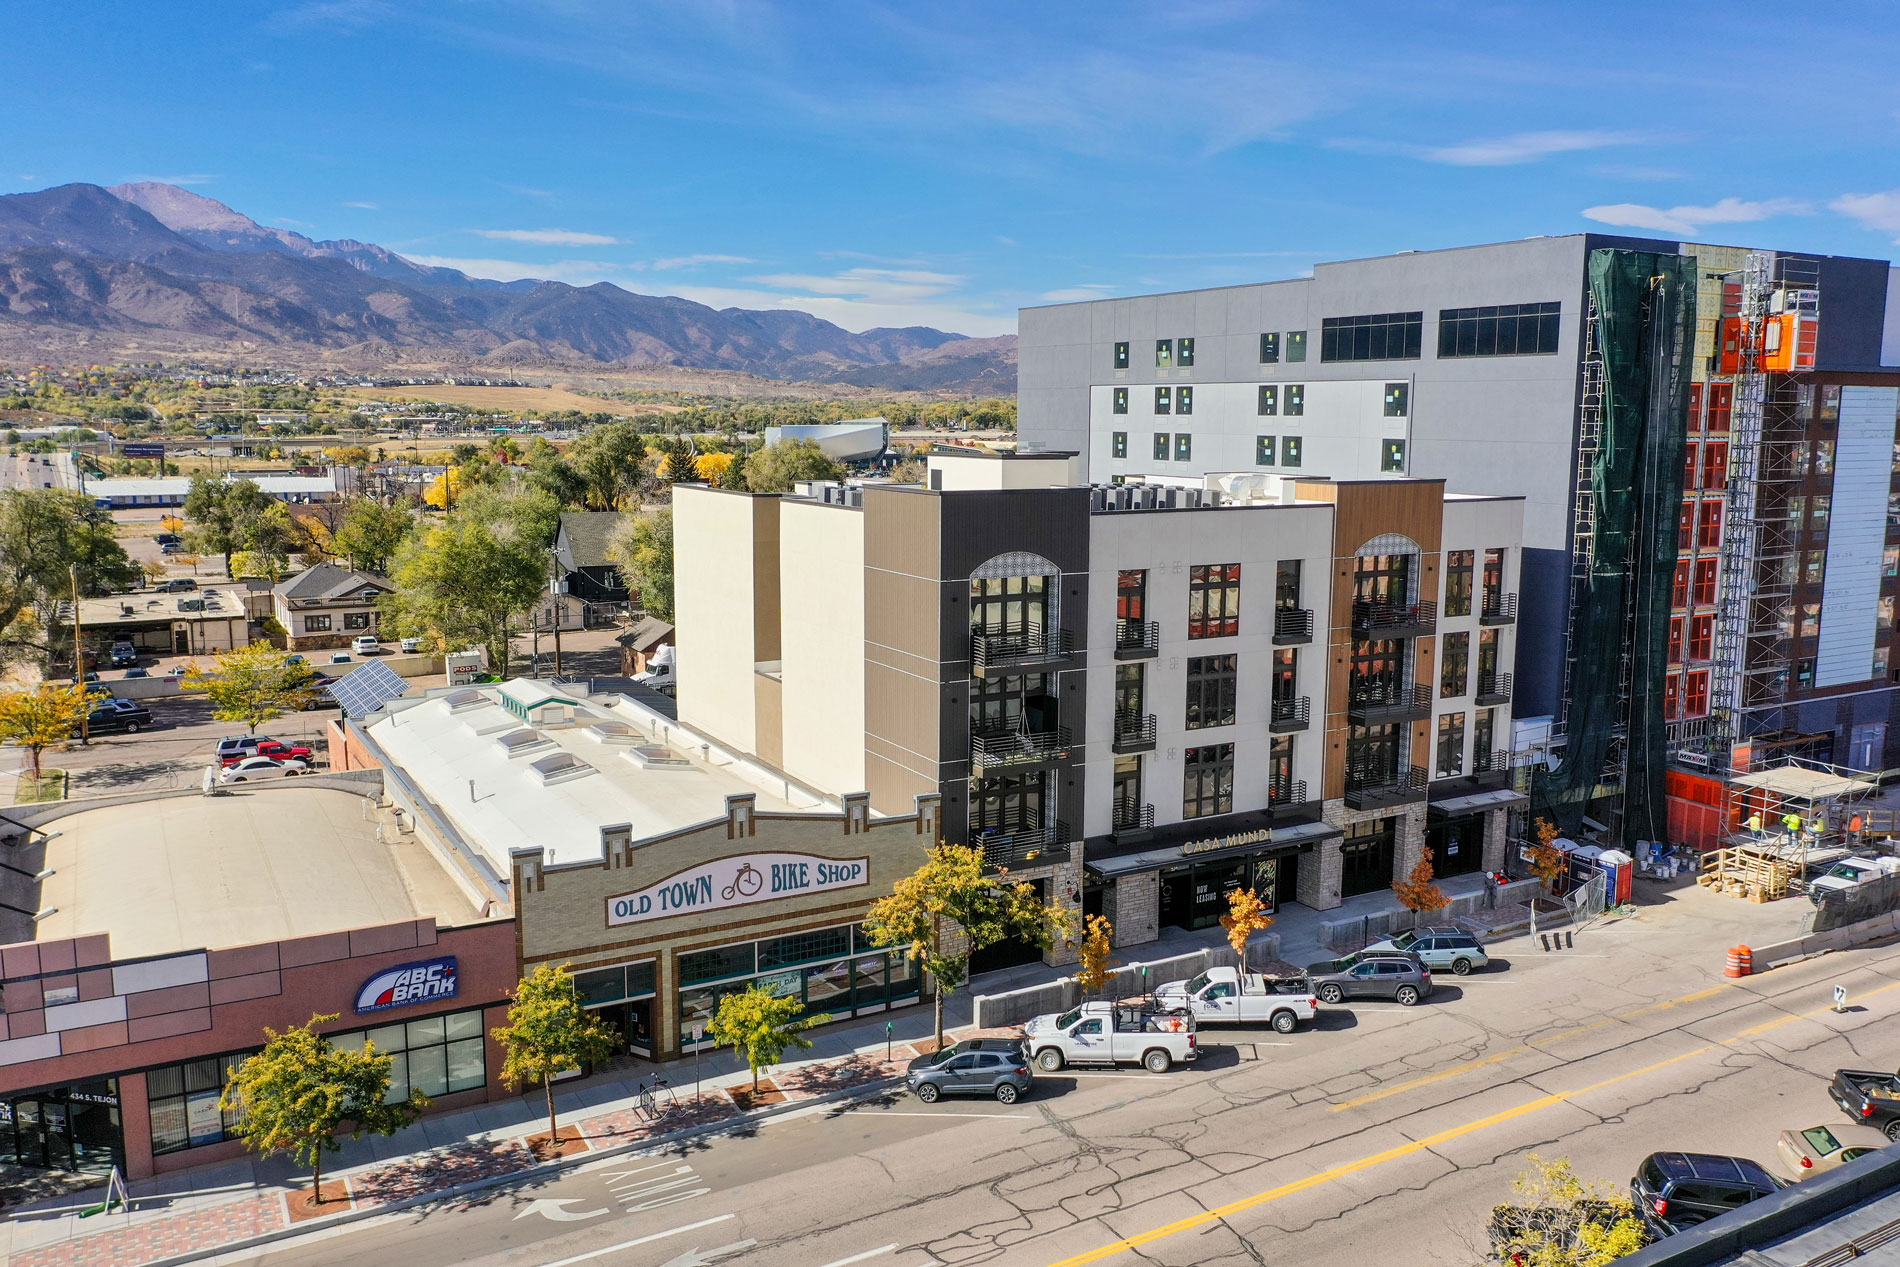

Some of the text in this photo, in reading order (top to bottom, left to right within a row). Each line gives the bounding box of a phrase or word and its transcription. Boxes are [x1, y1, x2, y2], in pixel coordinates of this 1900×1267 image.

[1183, 828, 1272, 854] CASA MUNDI
[615, 863, 861, 918] OLD TOWN BIKE SHOP
[1196, 885, 1208, 894] NOW
[1196, 892, 1217, 903] LEASING
[395, 964, 443, 986] ABC
[392, 976, 456, 1001] BANK
[358, 1003, 390, 1012] AMERICAN
[420, 992, 454, 1001] COMMERCE
[93, 1095, 117, 1104] TEJON
